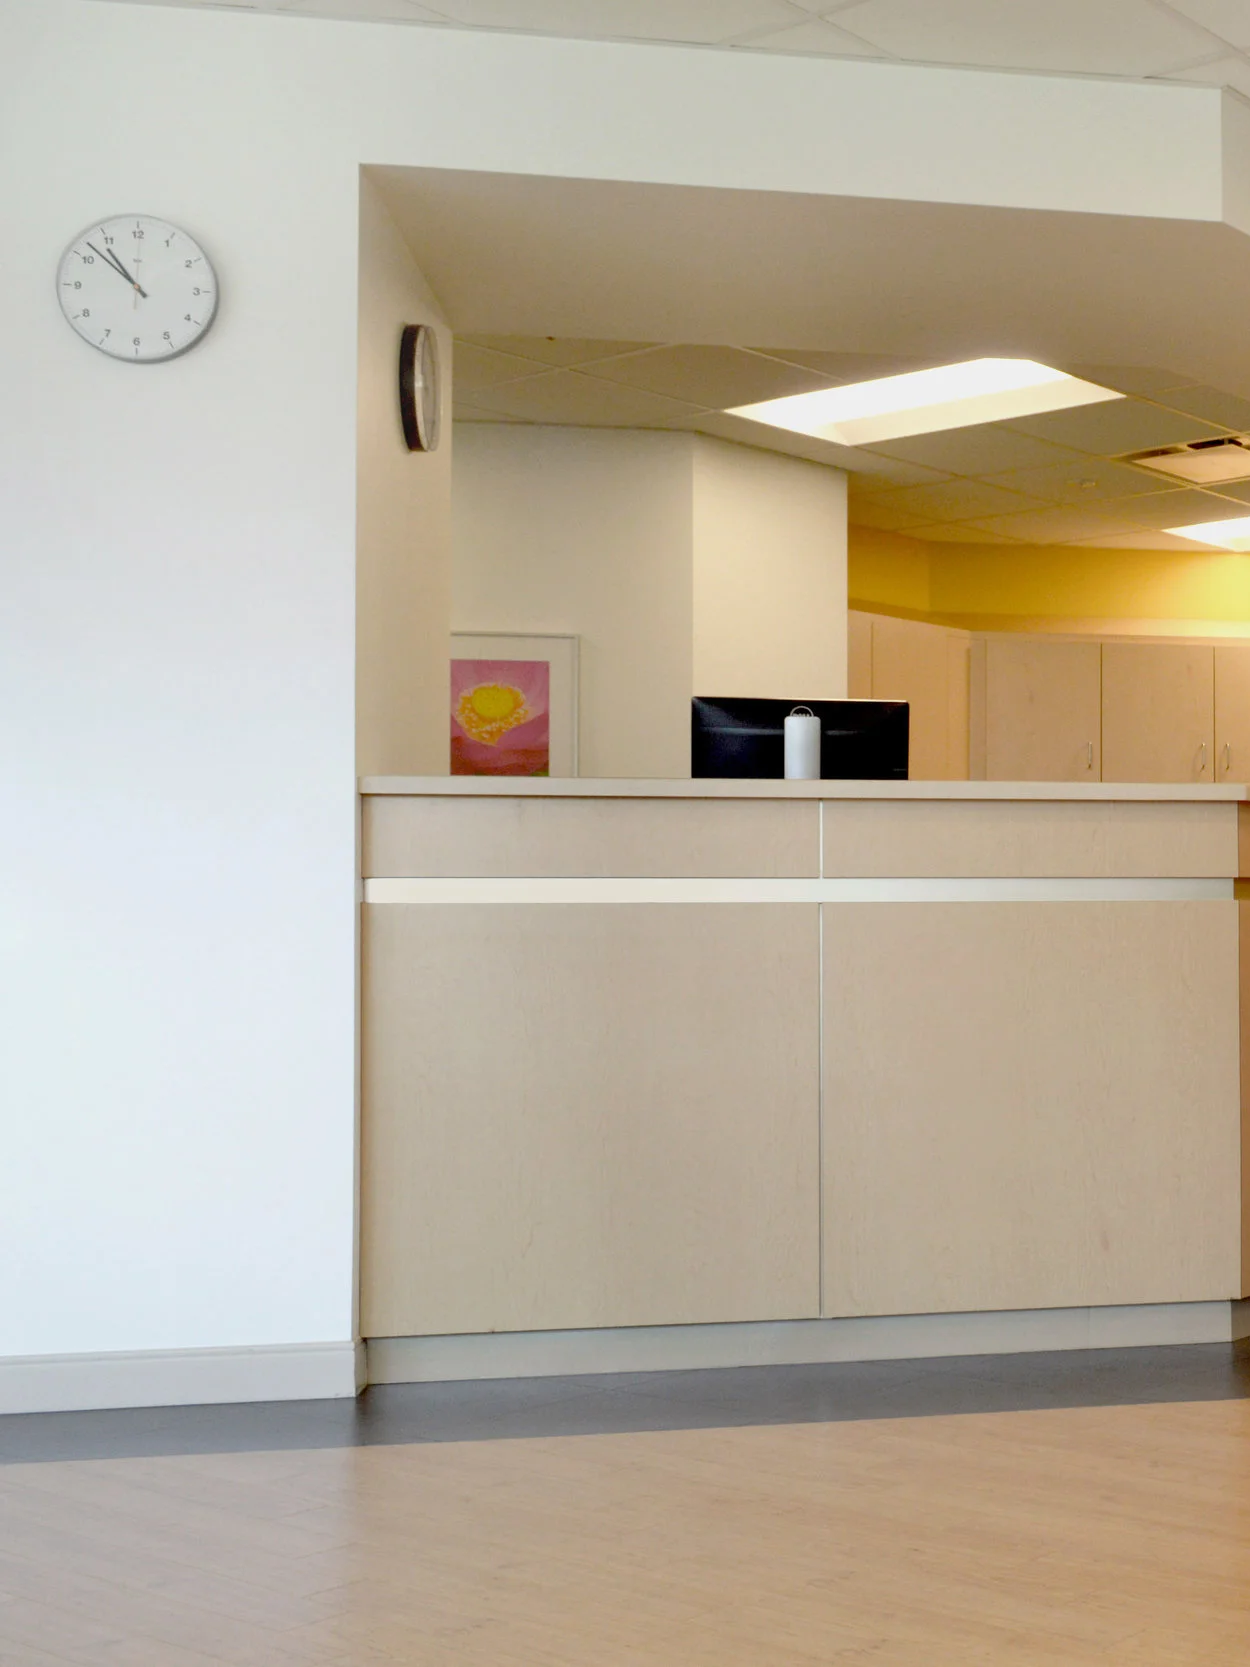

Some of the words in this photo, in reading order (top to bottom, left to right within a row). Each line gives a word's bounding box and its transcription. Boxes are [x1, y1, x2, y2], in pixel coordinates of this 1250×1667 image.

[132, 230, 145, 240] 12
[104, 237, 114, 245] 11
[165, 239, 170, 247] 1
[82, 256, 94, 264] 10
[185, 260, 192, 268] 2
[74, 281, 82, 289] 9
[193, 288, 200, 296] 3
[82, 309, 90, 317] 8
[184, 314, 191, 322] 4
[104, 329, 111, 338] 7
[163, 331, 170, 340] 5
[133, 337, 140, 346] 6
